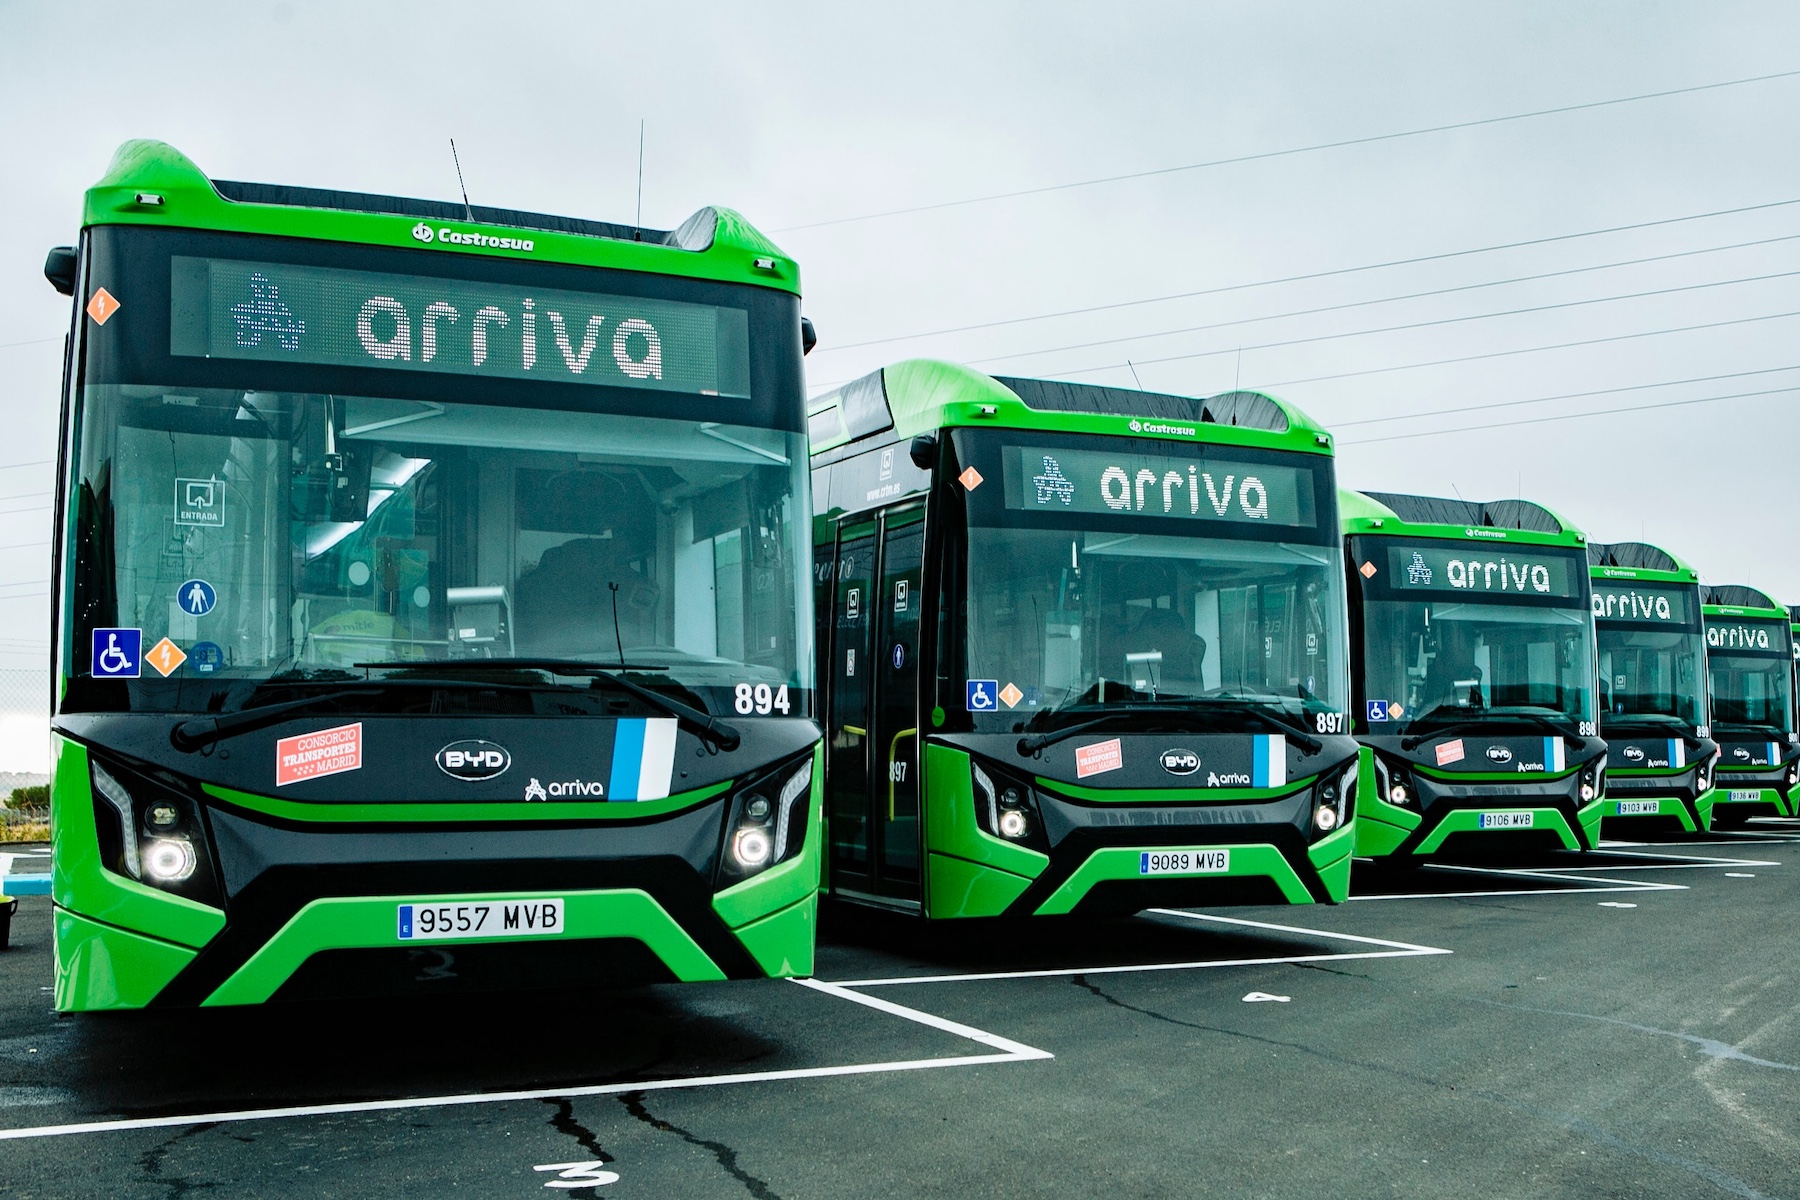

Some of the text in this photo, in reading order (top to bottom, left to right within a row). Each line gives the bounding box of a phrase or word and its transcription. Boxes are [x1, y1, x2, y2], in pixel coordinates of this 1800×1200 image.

[438, 228, 534, 251] Castrosua
[357, 296, 662, 380] arriva
[1143, 422, 1196, 436] Castrosua
[1100, 465, 1268, 519] arriva
[181, 511, 218, 521] ENTRADA
[1474, 529, 1507, 538] Castrosua
[1447, 557, 1550, 593] arriva
[1591, 591, 1671, 619] arriva
[1707, 626, 1769, 649] arriva
[735, 683, 791, 715] 894
[1316, 712, 1344, 733] 897
[1579, 721, 1597, 736] 898
[1696, 725, 1709, 738] 899
[298, 729, 357, 751] CONSORCIO
[283, 742, 356, 767] TRANSPORTES
[317, 754, 356, 773] MADRID
[445, 751, 504, 768] BYD
[1165, 756, 1197, 767] BYD
[1489, 750, 1510, 758] BYD
[889, 761, 907, 782] 897
[1220, 773, 1250, 784] arriva
[548, 779, 604, 796] arriva
[1622, 802, 1657, 812] 9103 MVB
[1486, 814, 1531, 826] 9106 MVB
[1151, 853, 1225, 871] 9089 MVB
[402, 904, 557, 933] E 9557 MVB
[532, 1160, 620, 1189] 3
